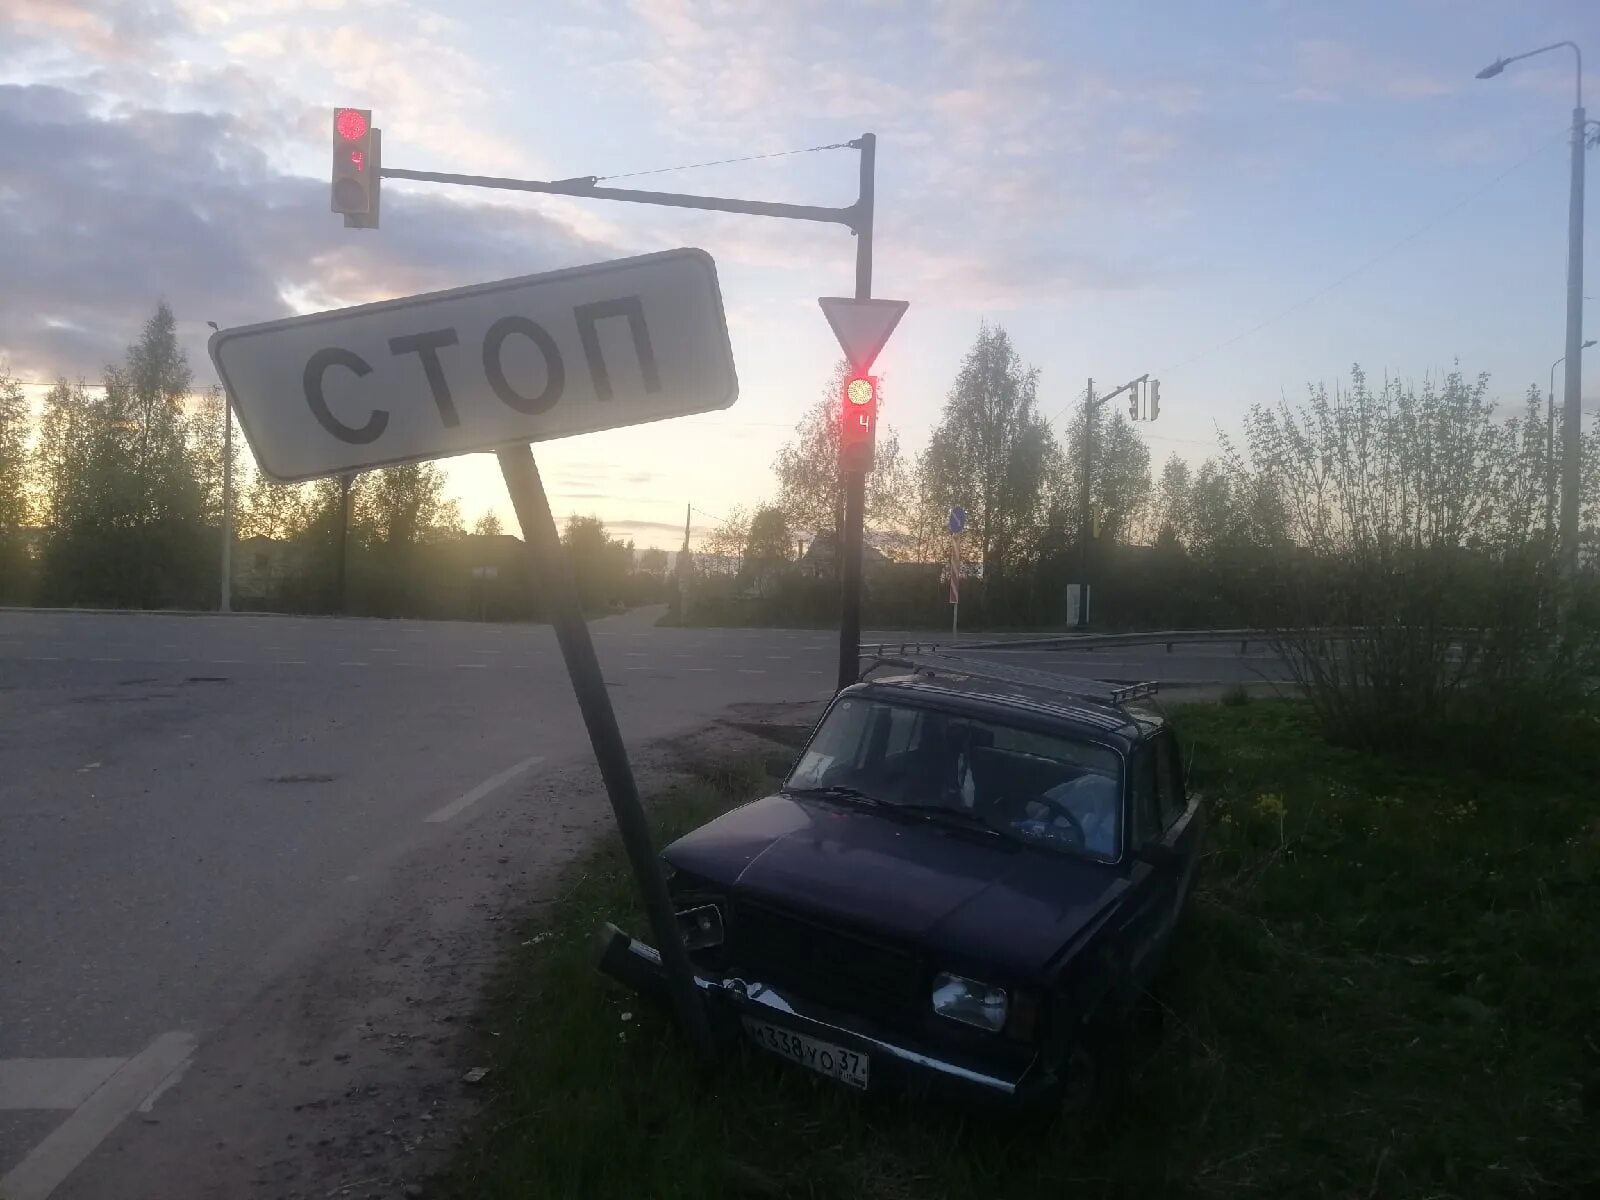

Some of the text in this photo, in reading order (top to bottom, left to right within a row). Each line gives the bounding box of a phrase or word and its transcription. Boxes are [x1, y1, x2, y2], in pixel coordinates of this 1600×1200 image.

[351, 151, 363, 174] 4
[303, 295, 661, 444] СТОП
[859, 414, 869, 433] 4
[837, 1050, 860, 1074] 37
